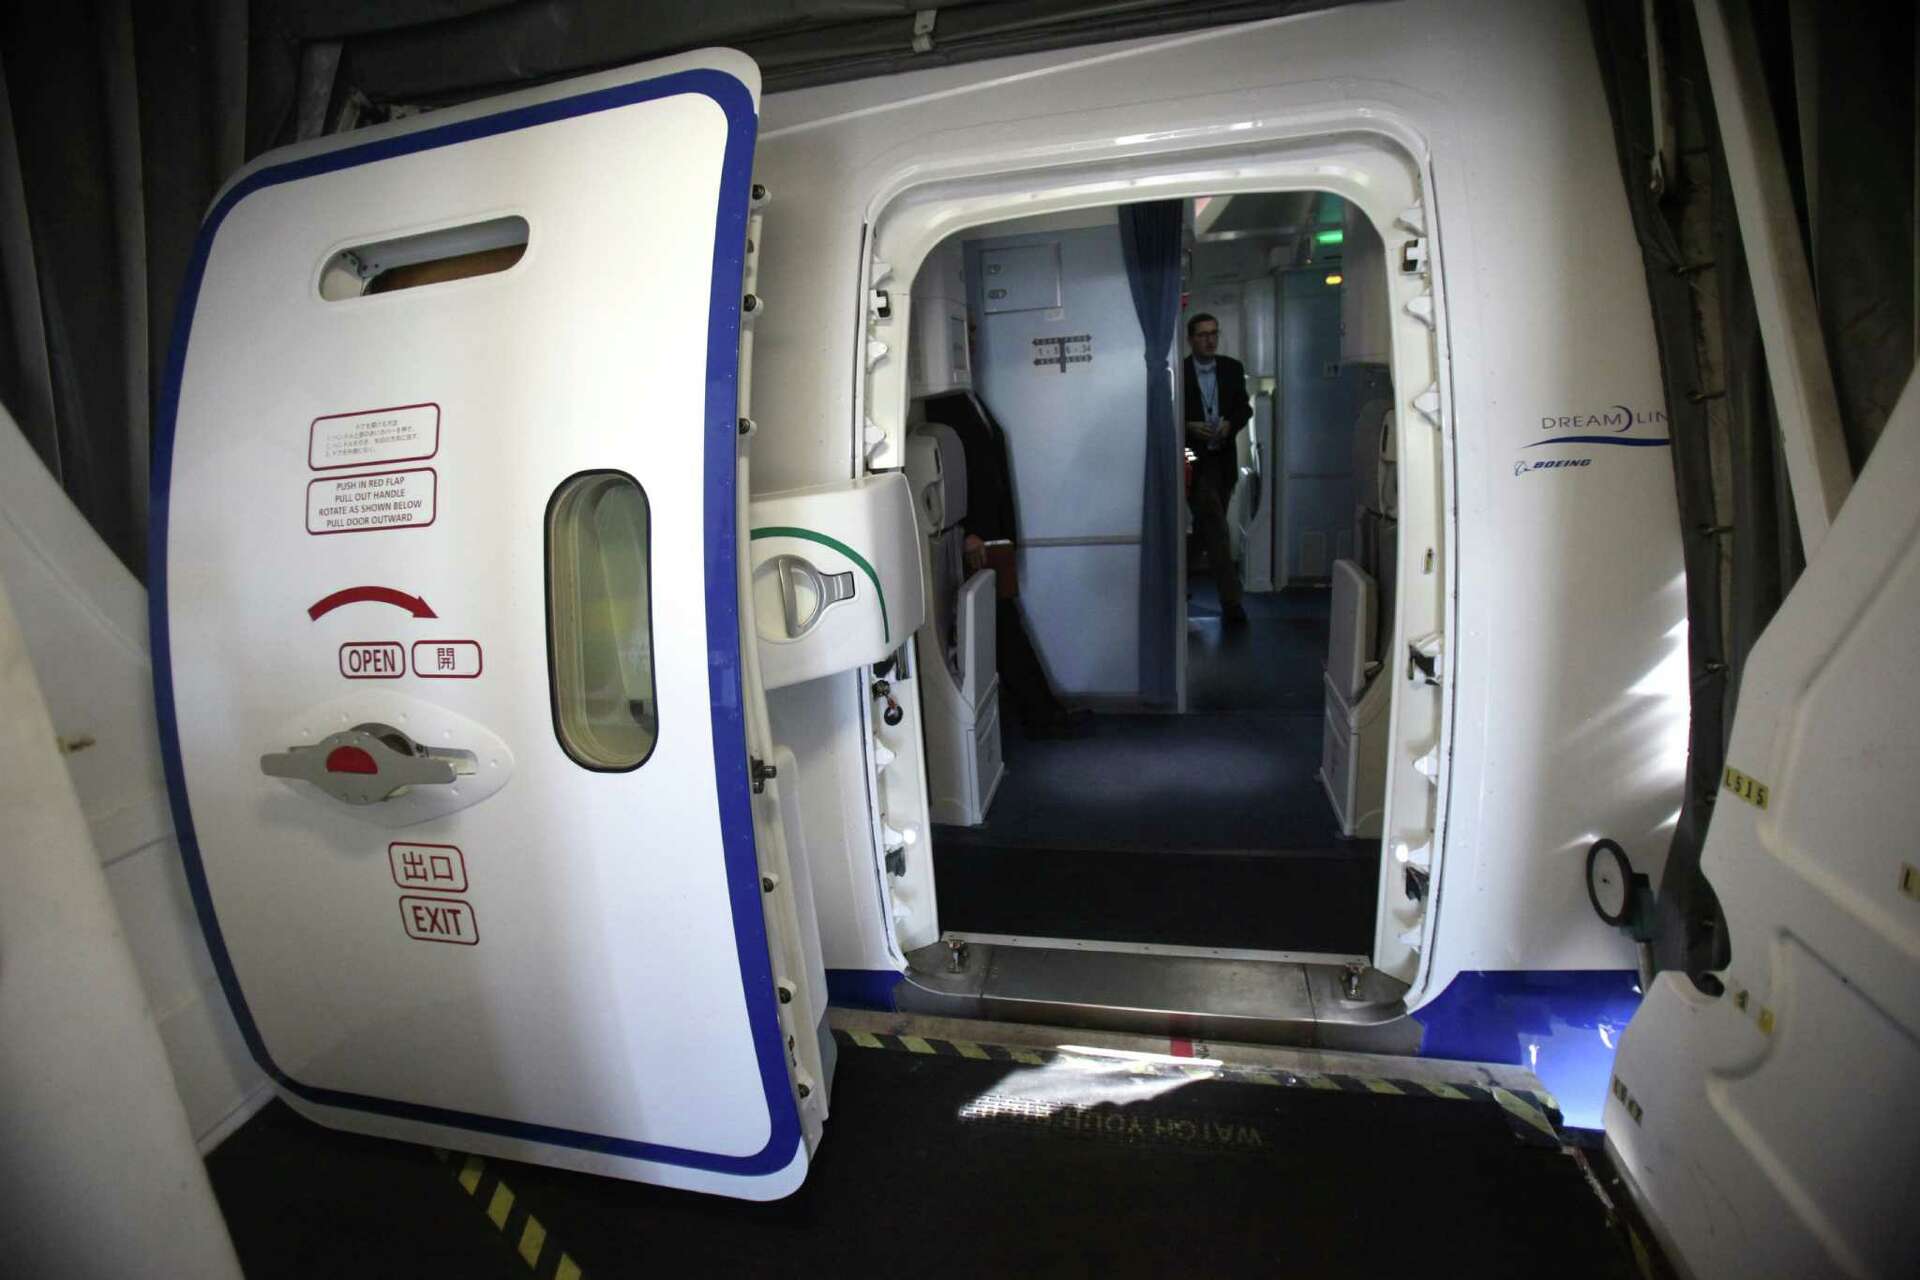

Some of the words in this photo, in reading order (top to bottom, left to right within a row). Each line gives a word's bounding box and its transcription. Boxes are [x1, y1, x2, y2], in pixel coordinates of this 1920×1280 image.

[1533, 459, 1592, 469] BOEING
[336, 481, 356, 491] PUSH
[368, 479, 384, 487] RED
[386, 476, 405, 486] FLAP
[335, 493, 353, 503] PULL
[354, 492, 371, 501] OUT
[373, 489, 405, 498] HANDLE
[319, 506, 347, 516] ROTATE
[349, 506, 359, 514] AS
[361, 502, 391, 513] SHOWN
[393, 500, 422, 509] BELOW
[326, 518, 344, 528] PULL
[346, 516, 370, 525] DOOR
[371, 513, 413, 524] OUTWARD
[349, 649, 396, 673] OPEN
[437, 647, 455, 671] 開
[402, 851, 454, 882] 出口
[412, 905, 461, 936] EXIT
[1154, 1117, 1263, 1147] WATCH
